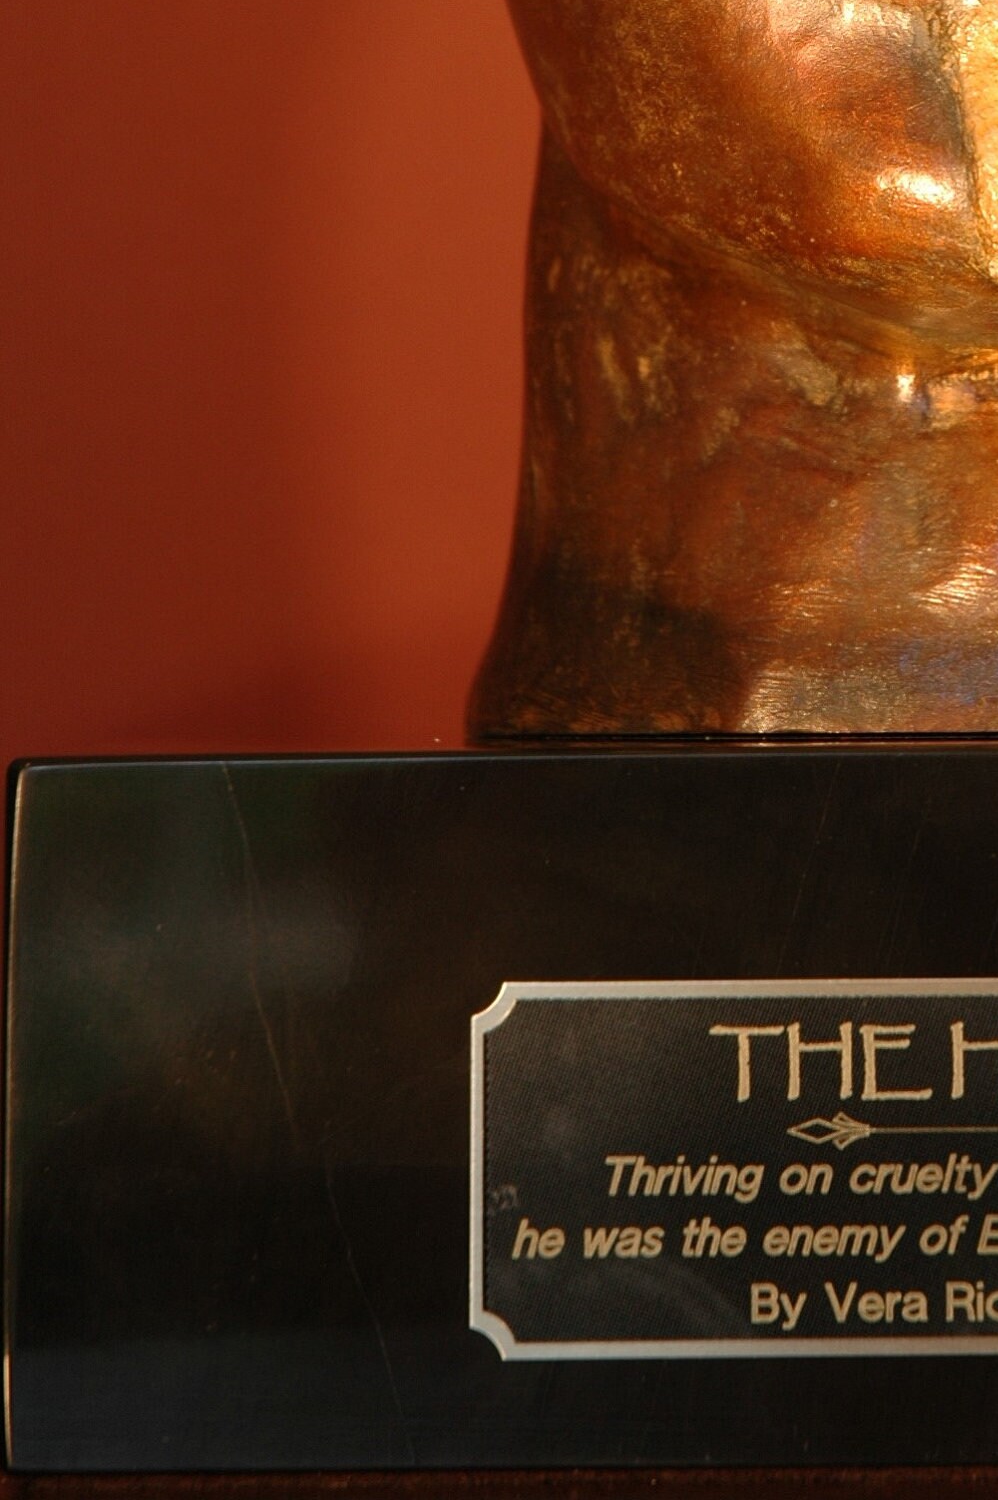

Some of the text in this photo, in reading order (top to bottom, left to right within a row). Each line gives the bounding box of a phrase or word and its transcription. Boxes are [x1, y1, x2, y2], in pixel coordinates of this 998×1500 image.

[709, 1021, 933, 1102] THE
[604, 1155, 765, 1202] Thriving
[780, 1165, 833, 1194] on
[511, 1219, 565, 1258] he
[584, 1227, 665, 1257] was
[682, 1217, 747, 1257] the
[763, 1226, 906, 1262] enemy
[920, 1216, 969, 1255] of
[750, 1283, 806, 1329] By
[825, 1283, 928, 1323] Vera
